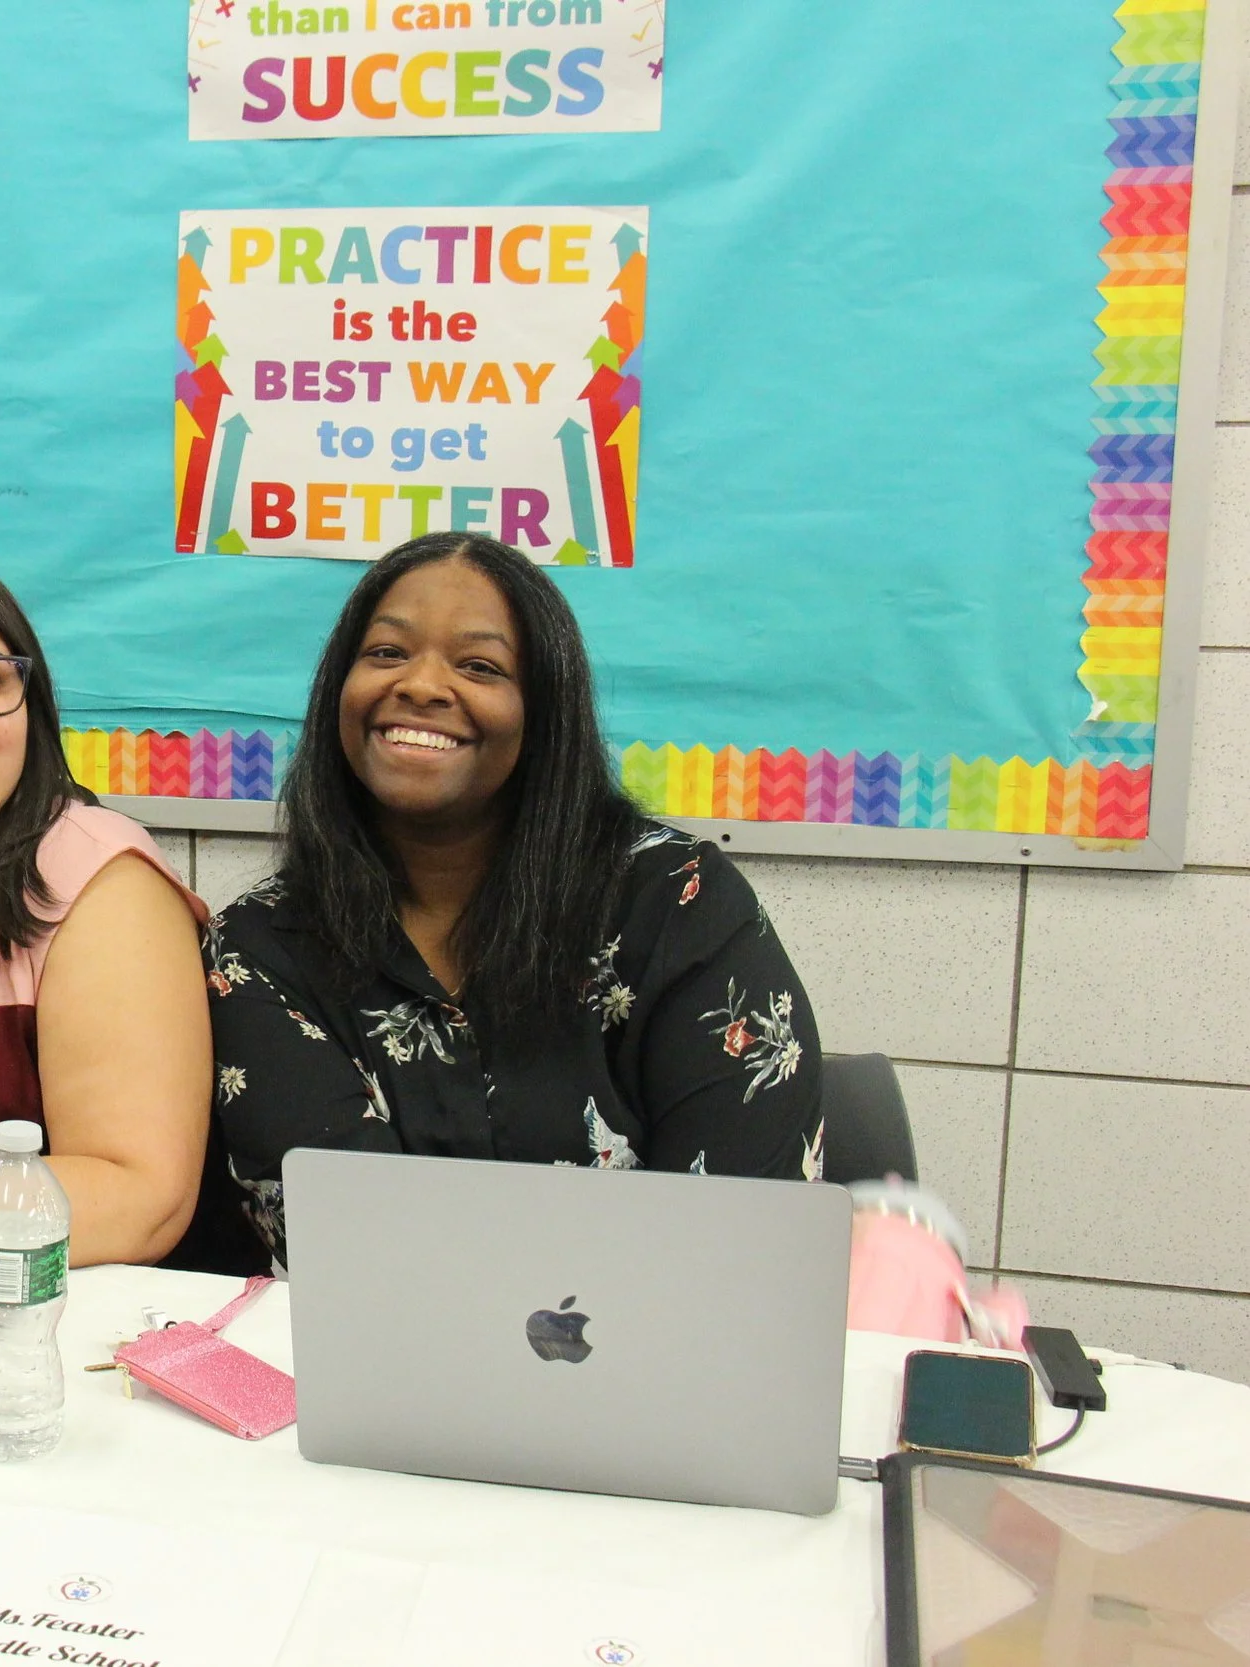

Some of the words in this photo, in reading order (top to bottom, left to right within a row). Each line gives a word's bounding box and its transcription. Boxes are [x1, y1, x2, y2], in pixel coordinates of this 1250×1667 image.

[247, 0, 349, 36] than
[392, 3, 471, 31] can
[485, 0, 602, 27] from
[241, 47, 604, 122] SUCCESS
[229, 224, 592, 286] PRACTICE
[332, 298, 374, 342] is
[388, 300, 478, 343] the
[255, 360, 392, 402] BEST
[407, 362, 556, 405] WAY
[317, 420, 374, 460] to
[390, 422, 488, 472] get
[250, 481, 552, 549] BETTER
[31, 1613, 145, 1641] Feaster
